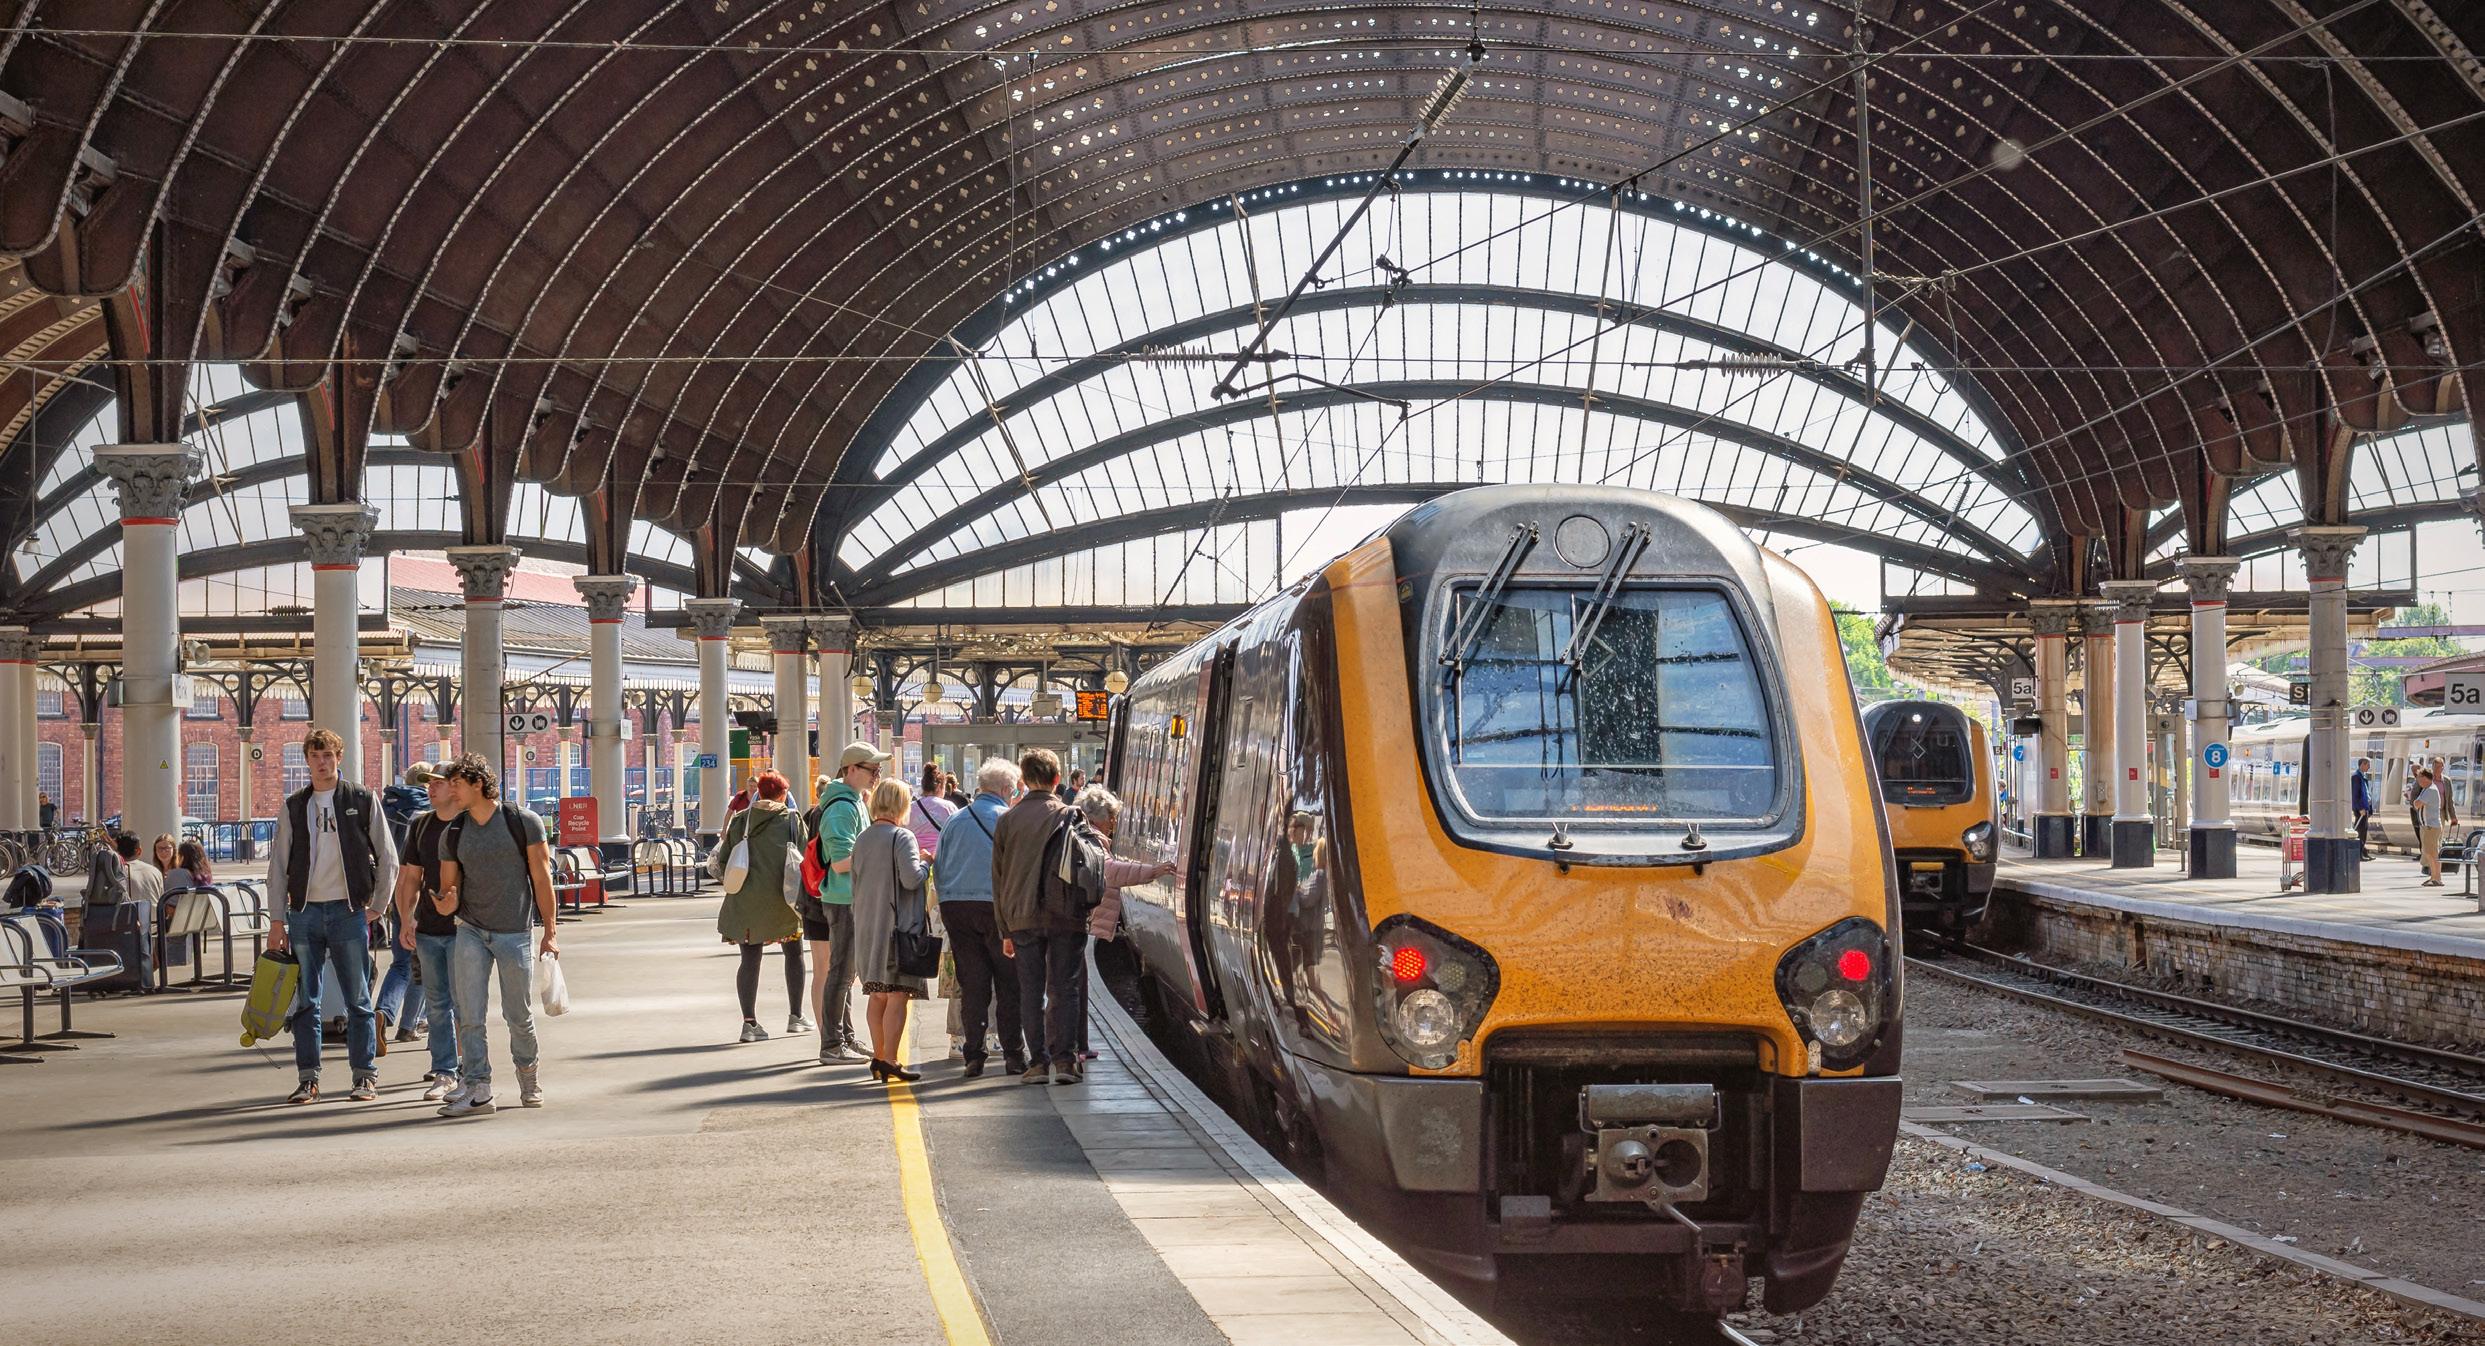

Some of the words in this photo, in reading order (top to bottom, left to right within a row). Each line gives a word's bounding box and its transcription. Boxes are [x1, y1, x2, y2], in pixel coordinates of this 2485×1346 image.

[2012, 681, 2032, 695] 5a
[2450, 683, 2480, 704] 5a
[2211, 750, 2221, 763] 8
[701, 759, 716, 769] 234
